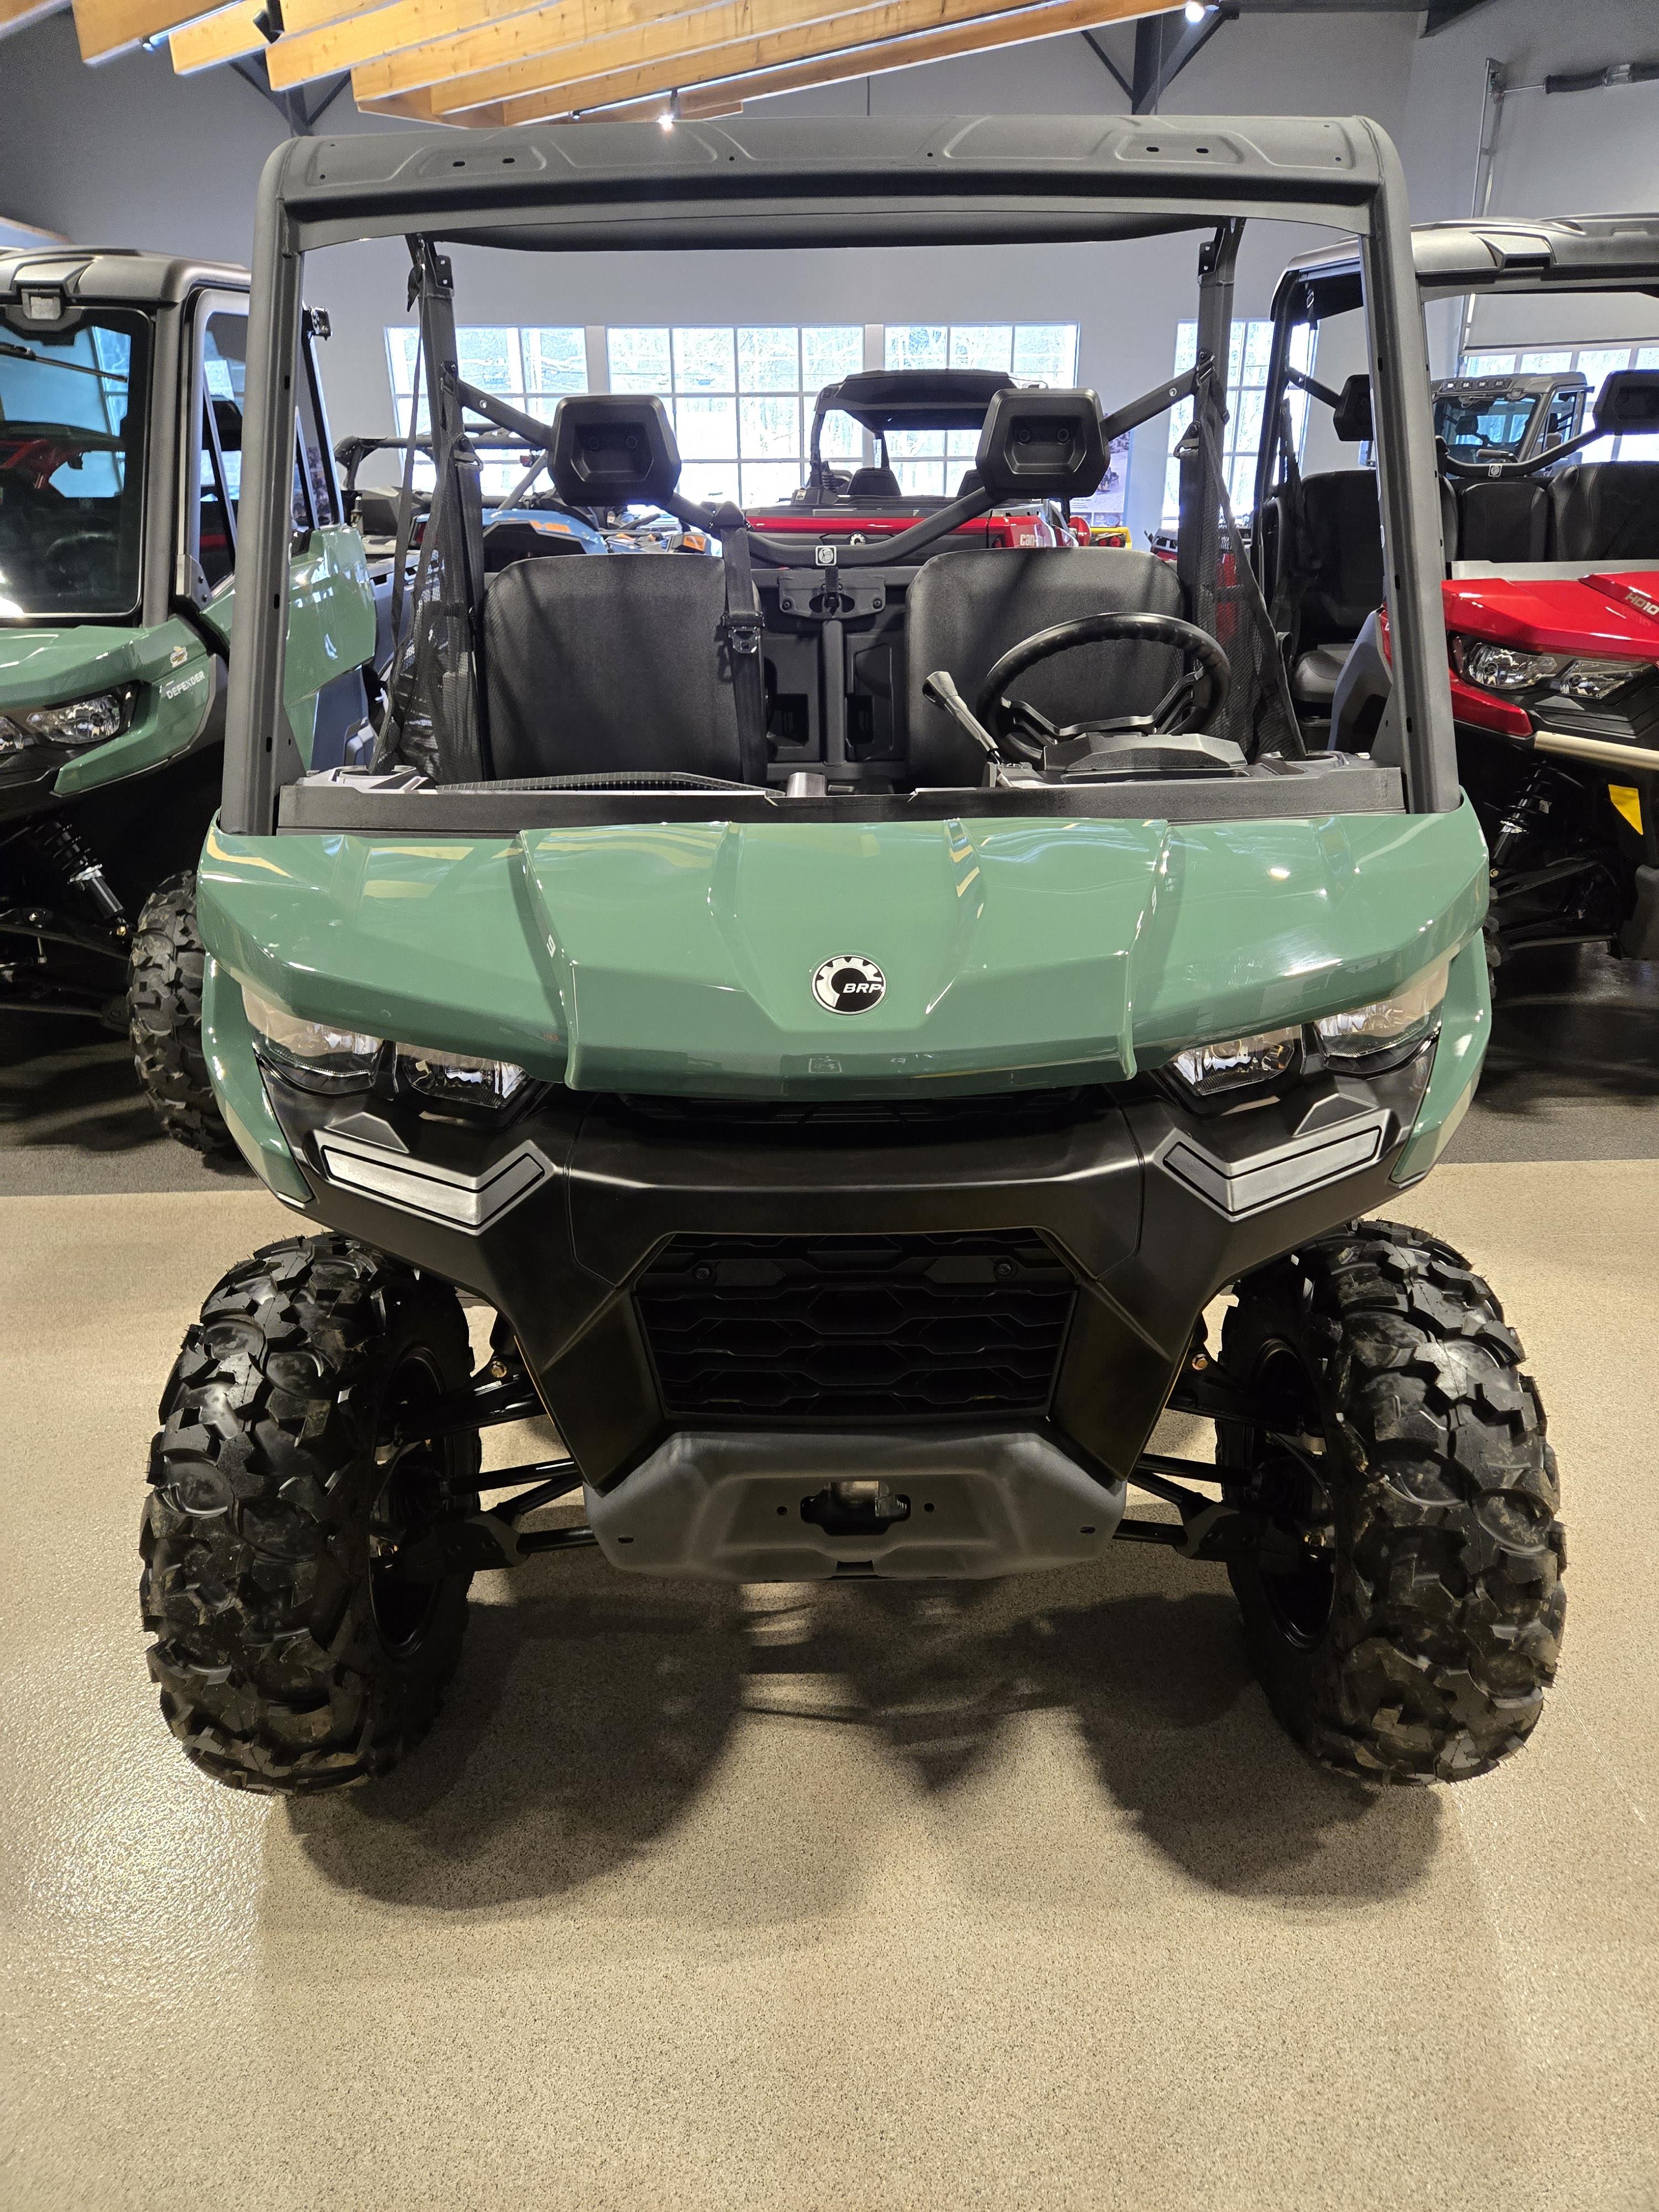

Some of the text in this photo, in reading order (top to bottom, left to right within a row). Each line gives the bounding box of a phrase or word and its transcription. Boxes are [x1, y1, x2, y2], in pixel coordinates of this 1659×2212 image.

[1625, 592, 1659, 615] HD10
[166, 670, 205, 700] DEFENDER
[842, 983, 882, 993] BRP
